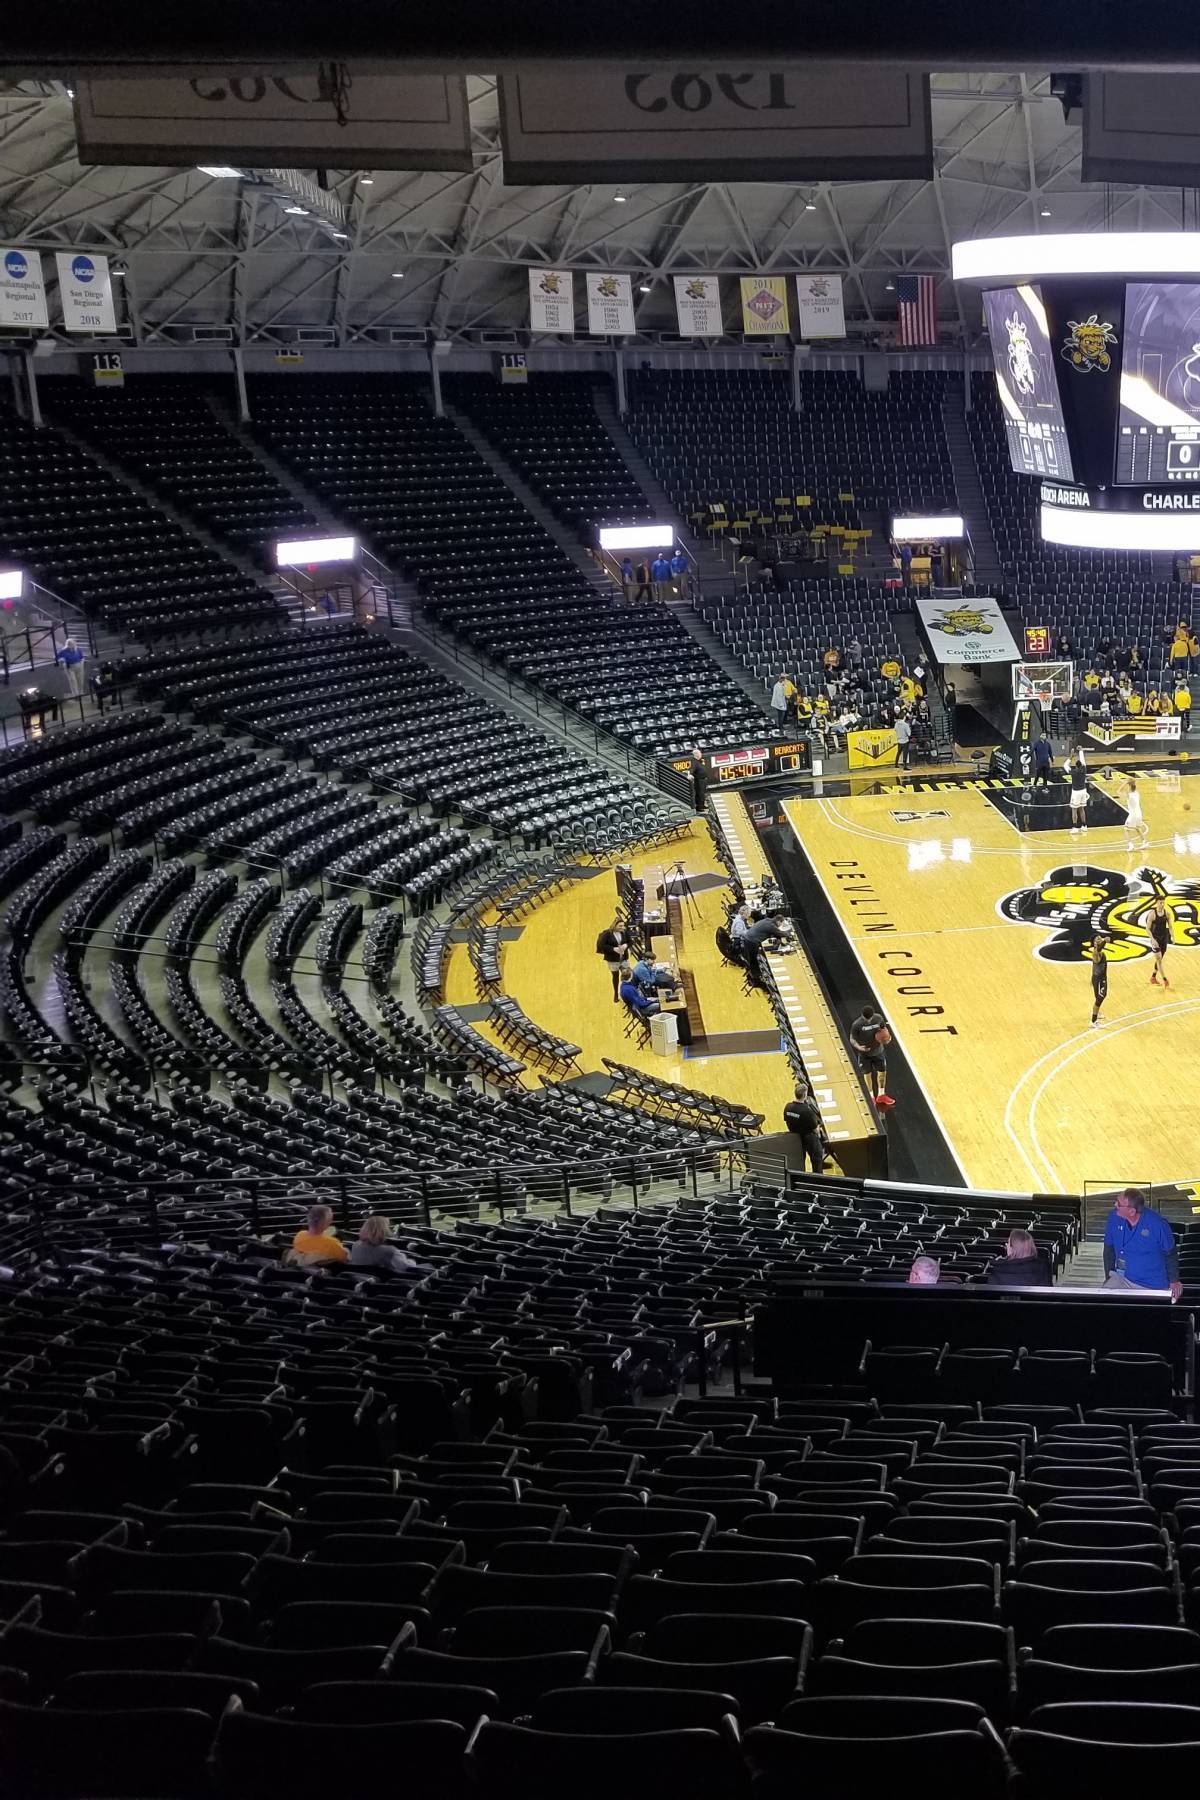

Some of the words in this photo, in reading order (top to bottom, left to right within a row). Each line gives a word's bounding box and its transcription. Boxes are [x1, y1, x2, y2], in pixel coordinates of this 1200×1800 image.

[753, 280, 773, 289] 2011
[70, 289, 82, 298] San
[84, 290, 104, 299] Diego
[81, 315, 101, 326] 2018
[749, 320, 784, 331] CHAMPIONS
[94, 354, 122, 370] 113
[501, 354, 526, 368] 115
[1179, 445, 1192, 463] 0
[1057, 488, 1090, 507] ARENA
[1029, 637, 1044, 650] 23
[1022, 711, 1031, 740] WSU
[774, 743, 805, 756] BEARCATS
[791, 755, 799, 769] 0
[720, 764, 753, 780] 45:40
[830, 861, 897, 932] DEVLIN
[878, 951, 958, 1035] COURT
